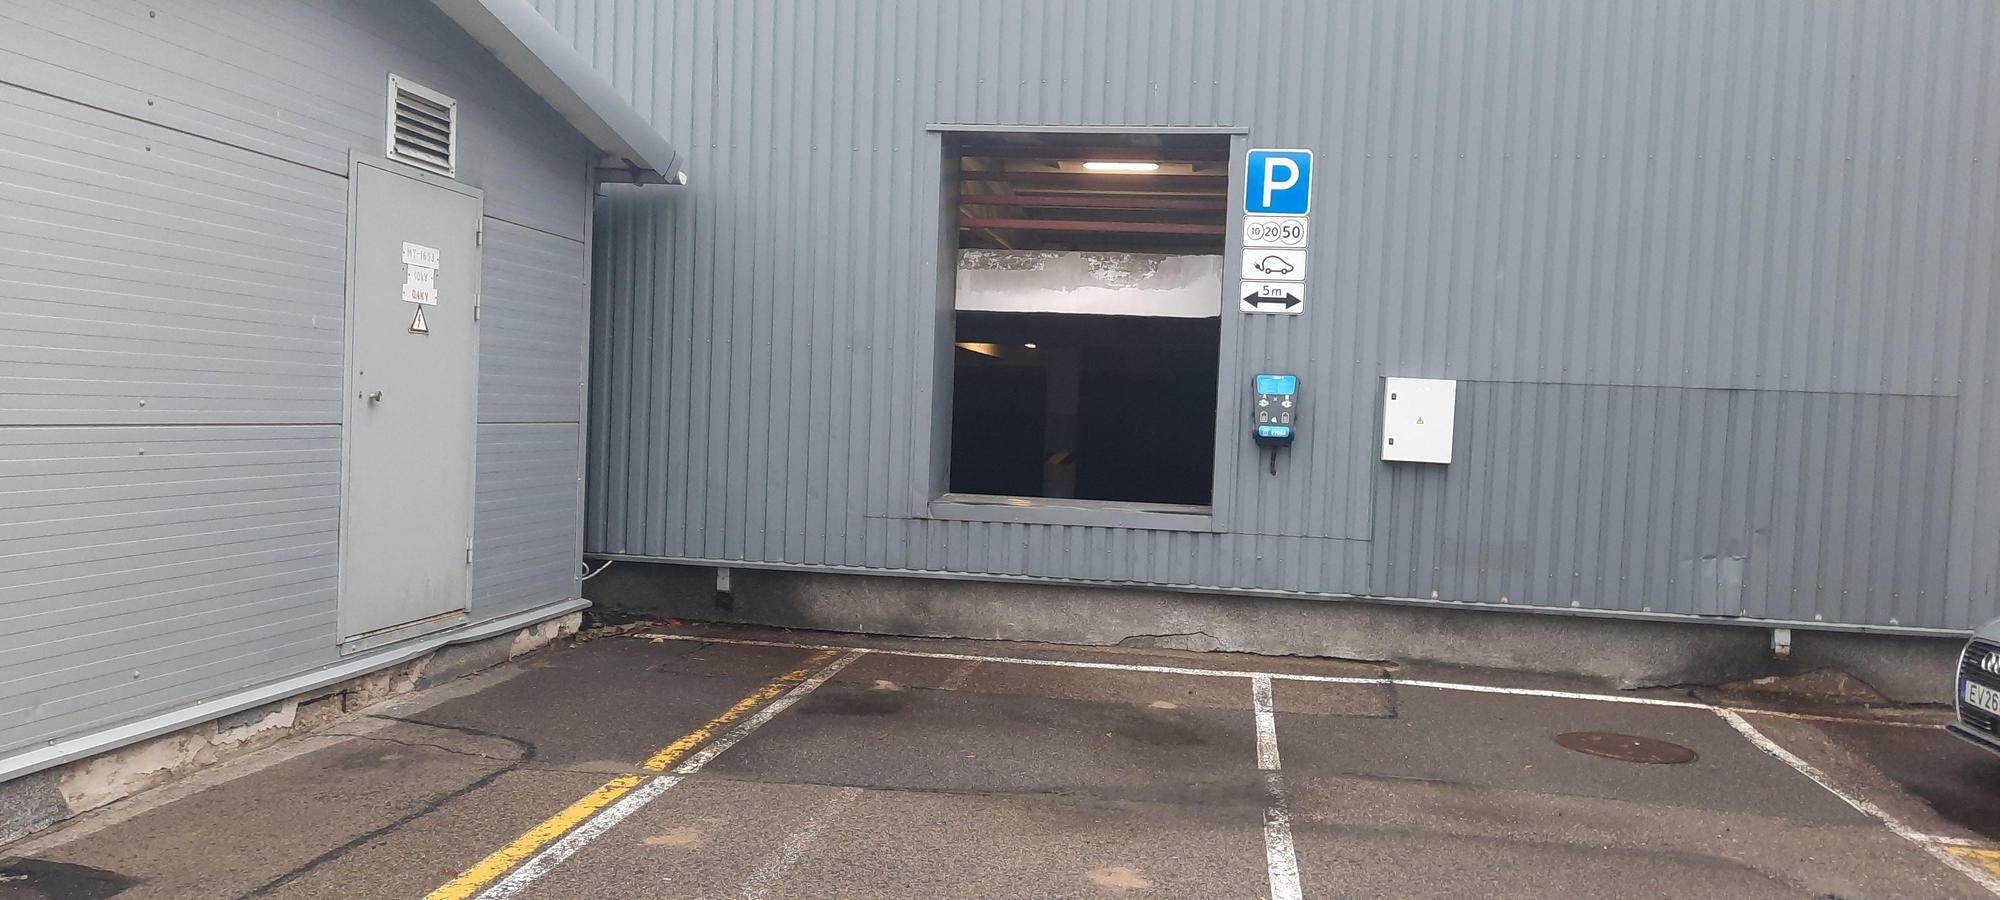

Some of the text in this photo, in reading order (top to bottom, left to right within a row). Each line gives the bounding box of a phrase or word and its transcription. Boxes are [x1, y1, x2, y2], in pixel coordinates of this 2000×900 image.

[1262, 157, 1300, 208] P
[1251, 225, 1301, 239] 10 20 50
